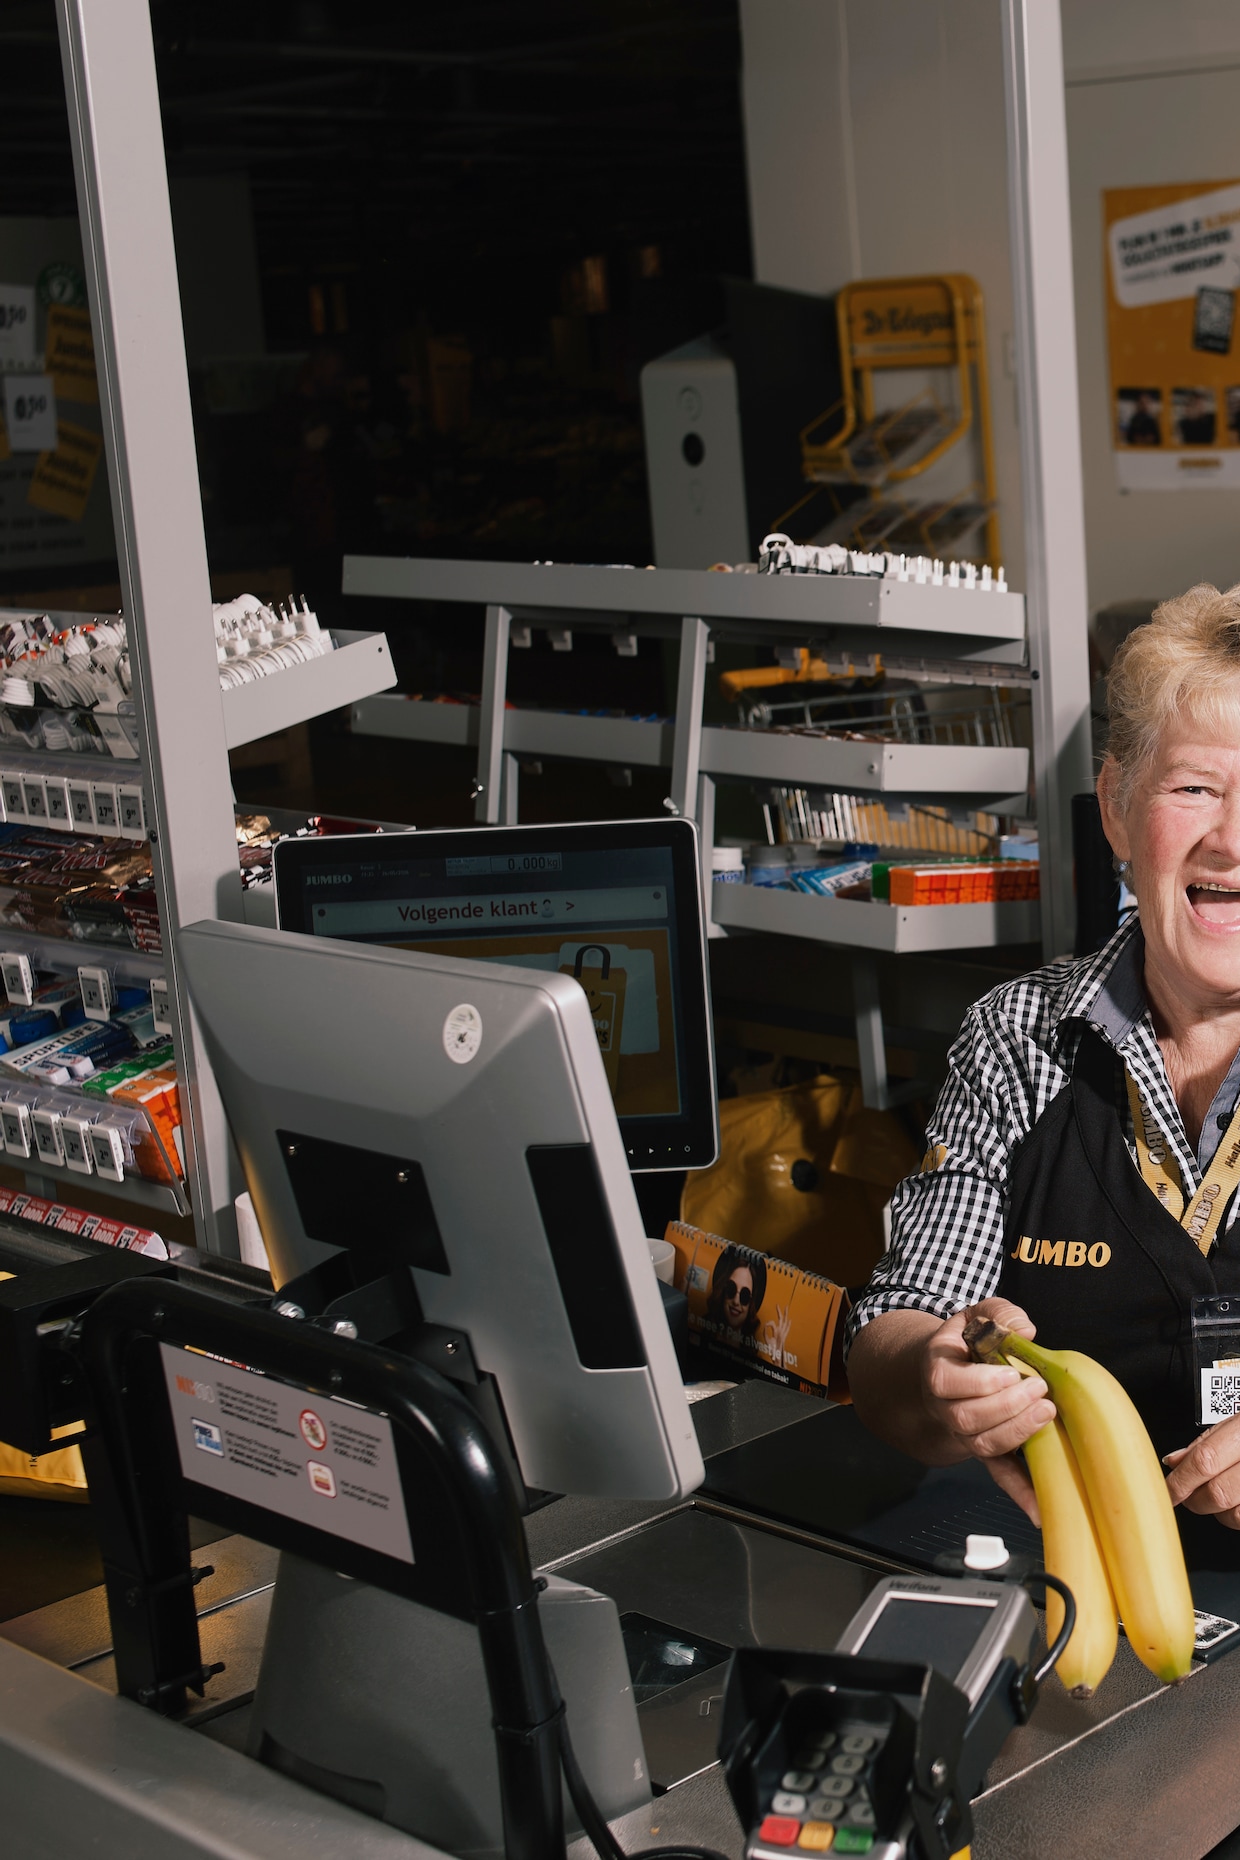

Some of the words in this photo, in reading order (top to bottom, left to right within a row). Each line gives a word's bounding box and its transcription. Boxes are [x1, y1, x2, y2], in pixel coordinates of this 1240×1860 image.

[305, 873, 353, 887] JUMBO
[398, 903, 484, 925] Volgende
[490, 900, 539, 918] klant
[13, 1022, 100, 1067] SPORTLIFE
[1011, 1235, 1112, 1268] JUMBO
